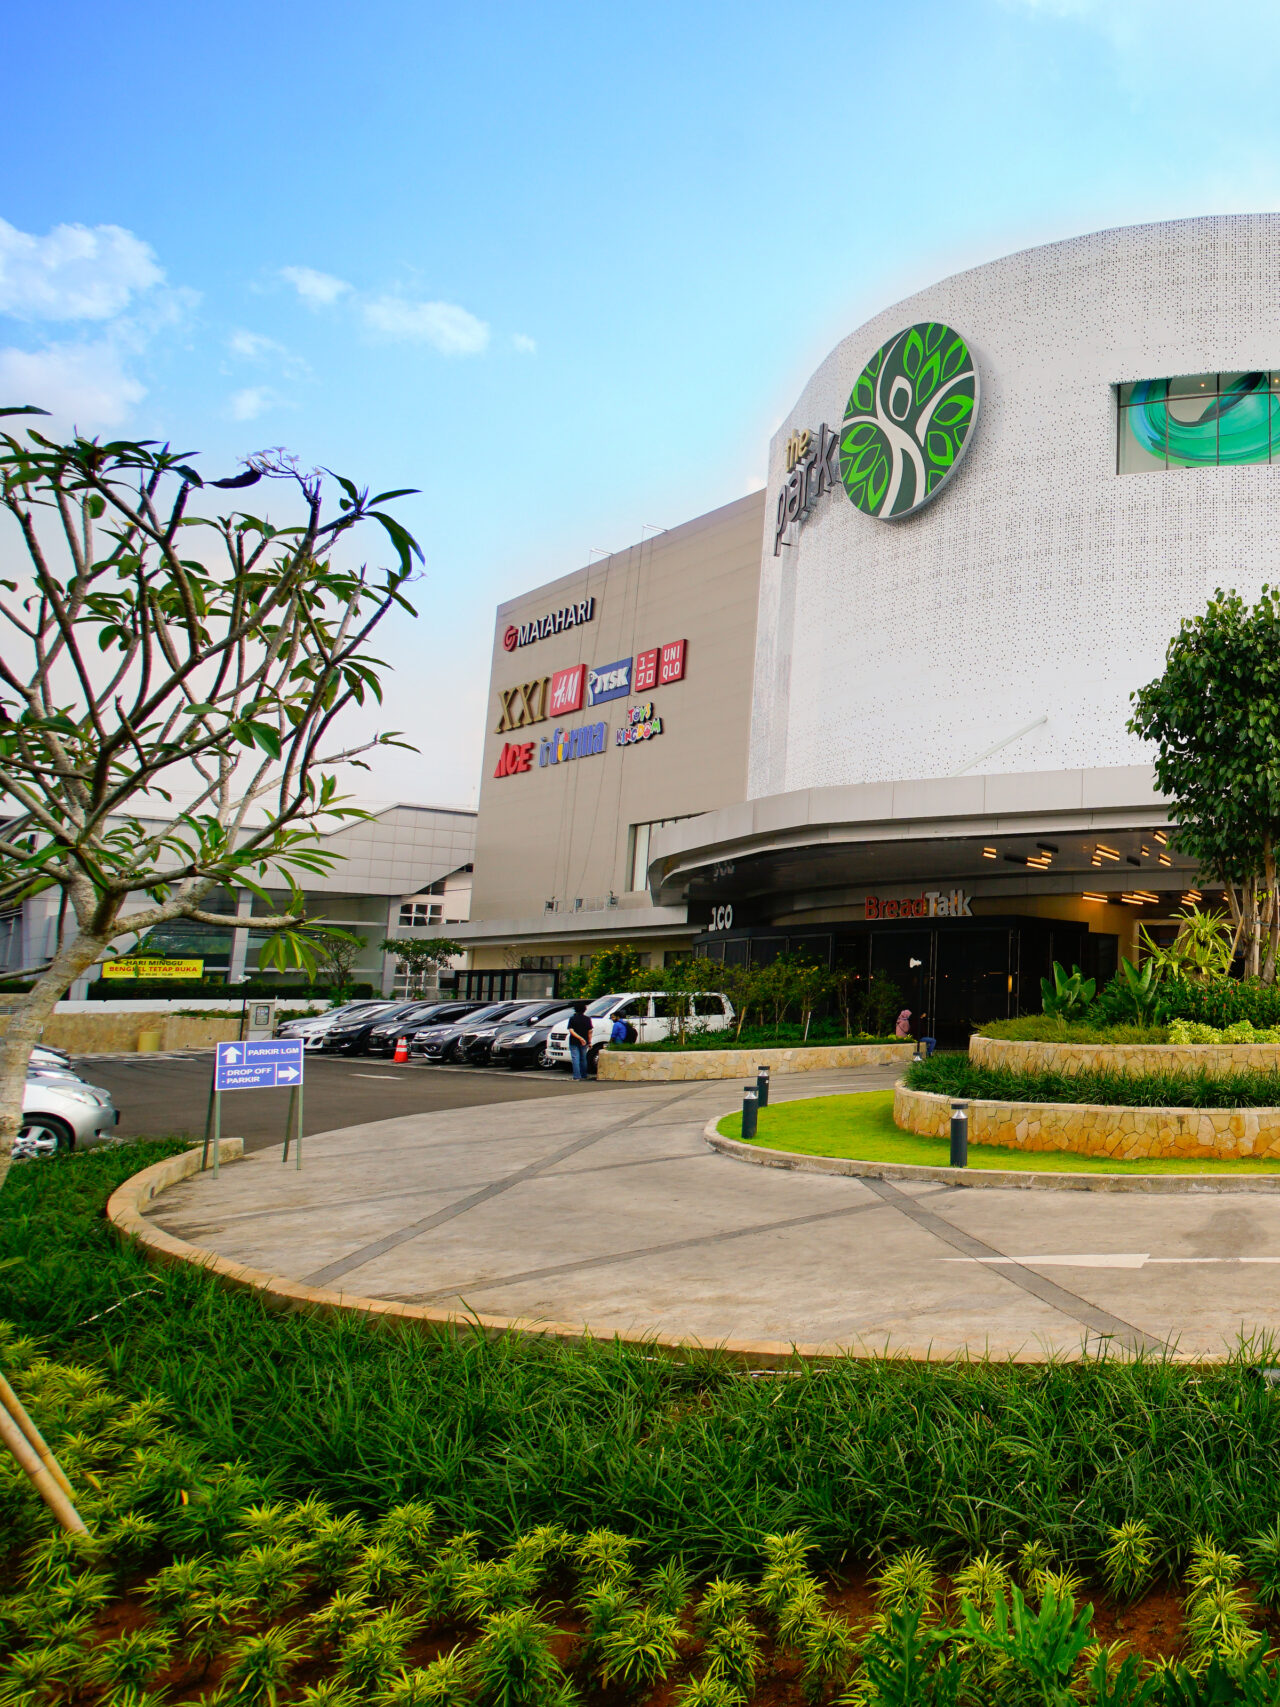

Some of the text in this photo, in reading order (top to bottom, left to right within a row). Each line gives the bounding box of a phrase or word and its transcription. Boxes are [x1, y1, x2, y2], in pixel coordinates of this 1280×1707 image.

[786, 429, 813, 473] the
[774, 423, 840, 557] park
[516, 597, 596, 648] MATAHARI
[639, 653, 655, 670] ユニ
[663, 645, 680, 662] UNI
[594, 667, 630, 694] JYSK
[662, 662, 681, 680] QLO
[553, 671, 580, 709] H&M
[494, 676, 550, 734] XXI
[628, 702, 654, 725] TOYS
[539, 721, 607, 767] informa
[616, 717, 663, 746] KINGDOM
[493, 742, 536, 778] ACE
[865, 889, 973, 921] BreadTalk
[247, 1047, 300, 1057] PARKIR LGM
[226, 1069, 253, 1077] DROP
[254, 1067, 273, 1075] OFF
[226, 1076, 260, 1085] PARKIR
